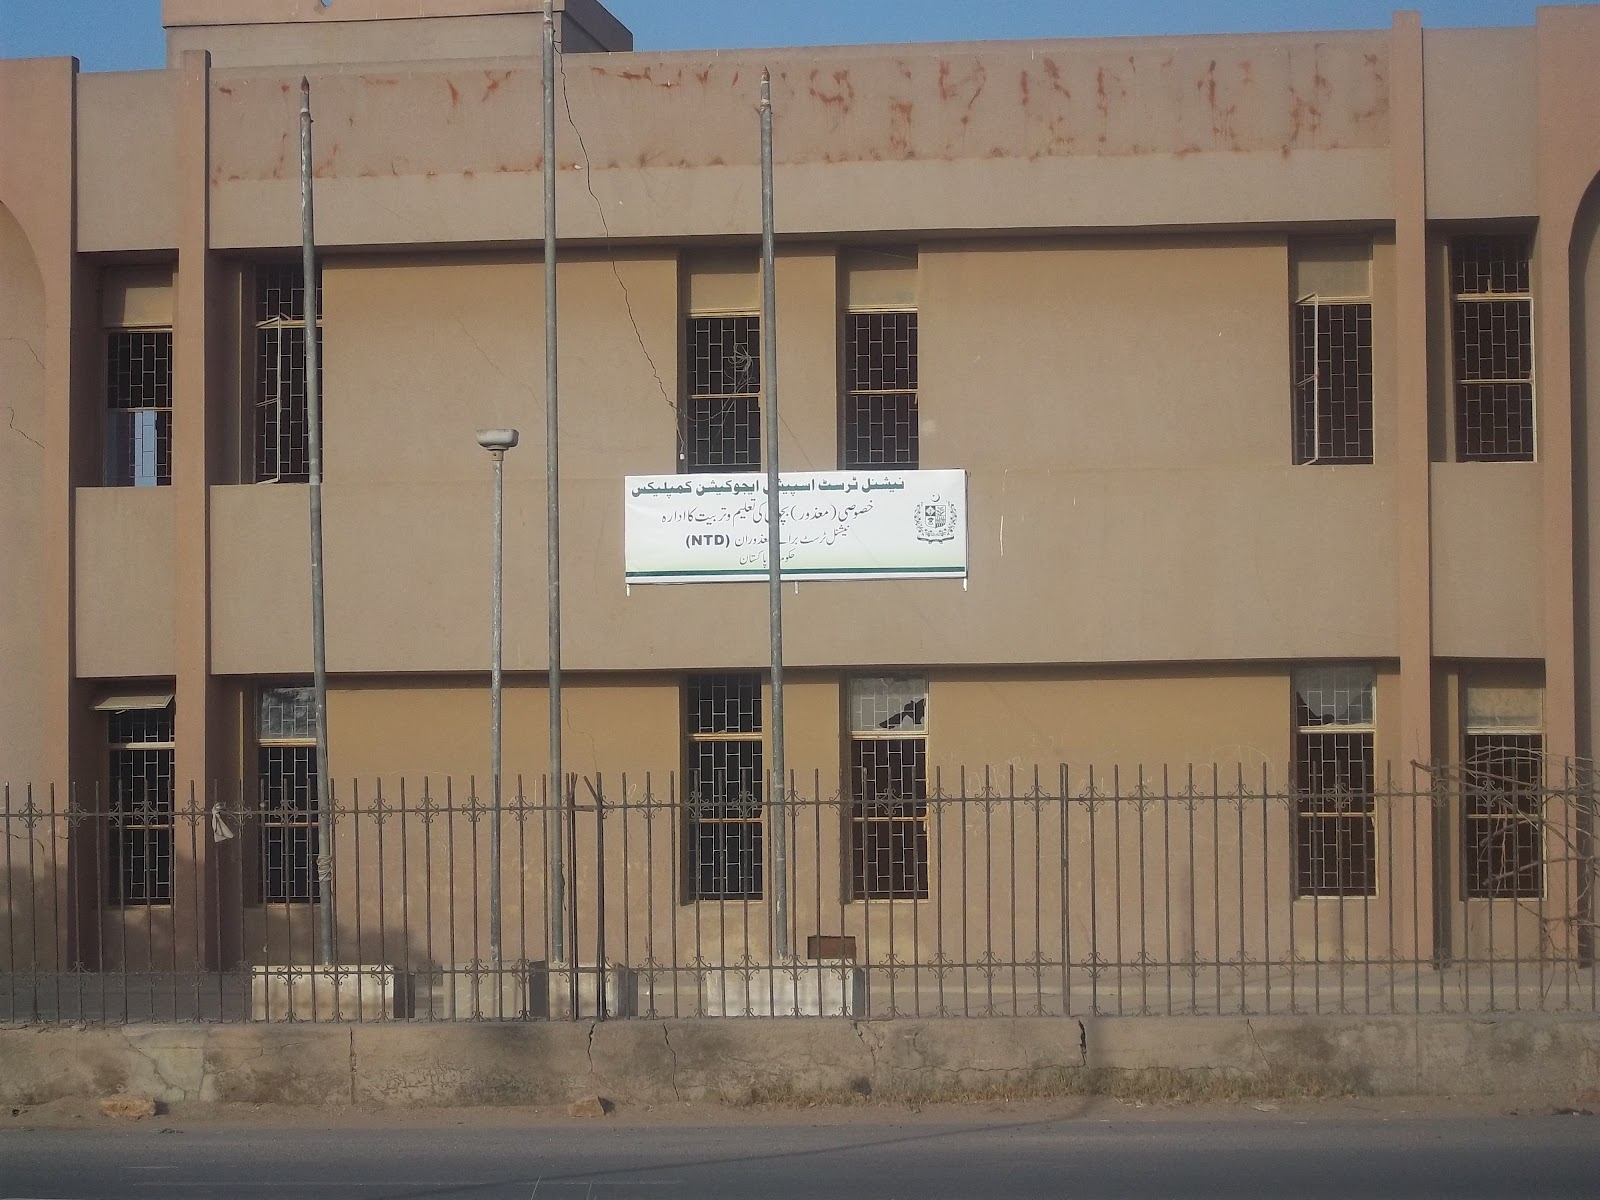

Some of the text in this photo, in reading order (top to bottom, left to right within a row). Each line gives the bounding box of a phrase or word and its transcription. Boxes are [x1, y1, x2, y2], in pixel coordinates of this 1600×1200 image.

[631, 476, 905, 499] نیشنل ٹرسٹ اسپیش ایجوکیشن کمپلیکس
[733, 498, 756, 527] تعلیم
[752, 500, 768, 524] کی
[838, 500, 874, 522] خصوصی
[685, 534, 731, 549] (NTD)
[734, 533, 770, 547] عذوران
[799, 532, 828, 545] ٹرسٹ
[826, 524, 851, 546] نیشنل
[739, 550, 767, 569] پاکستان
